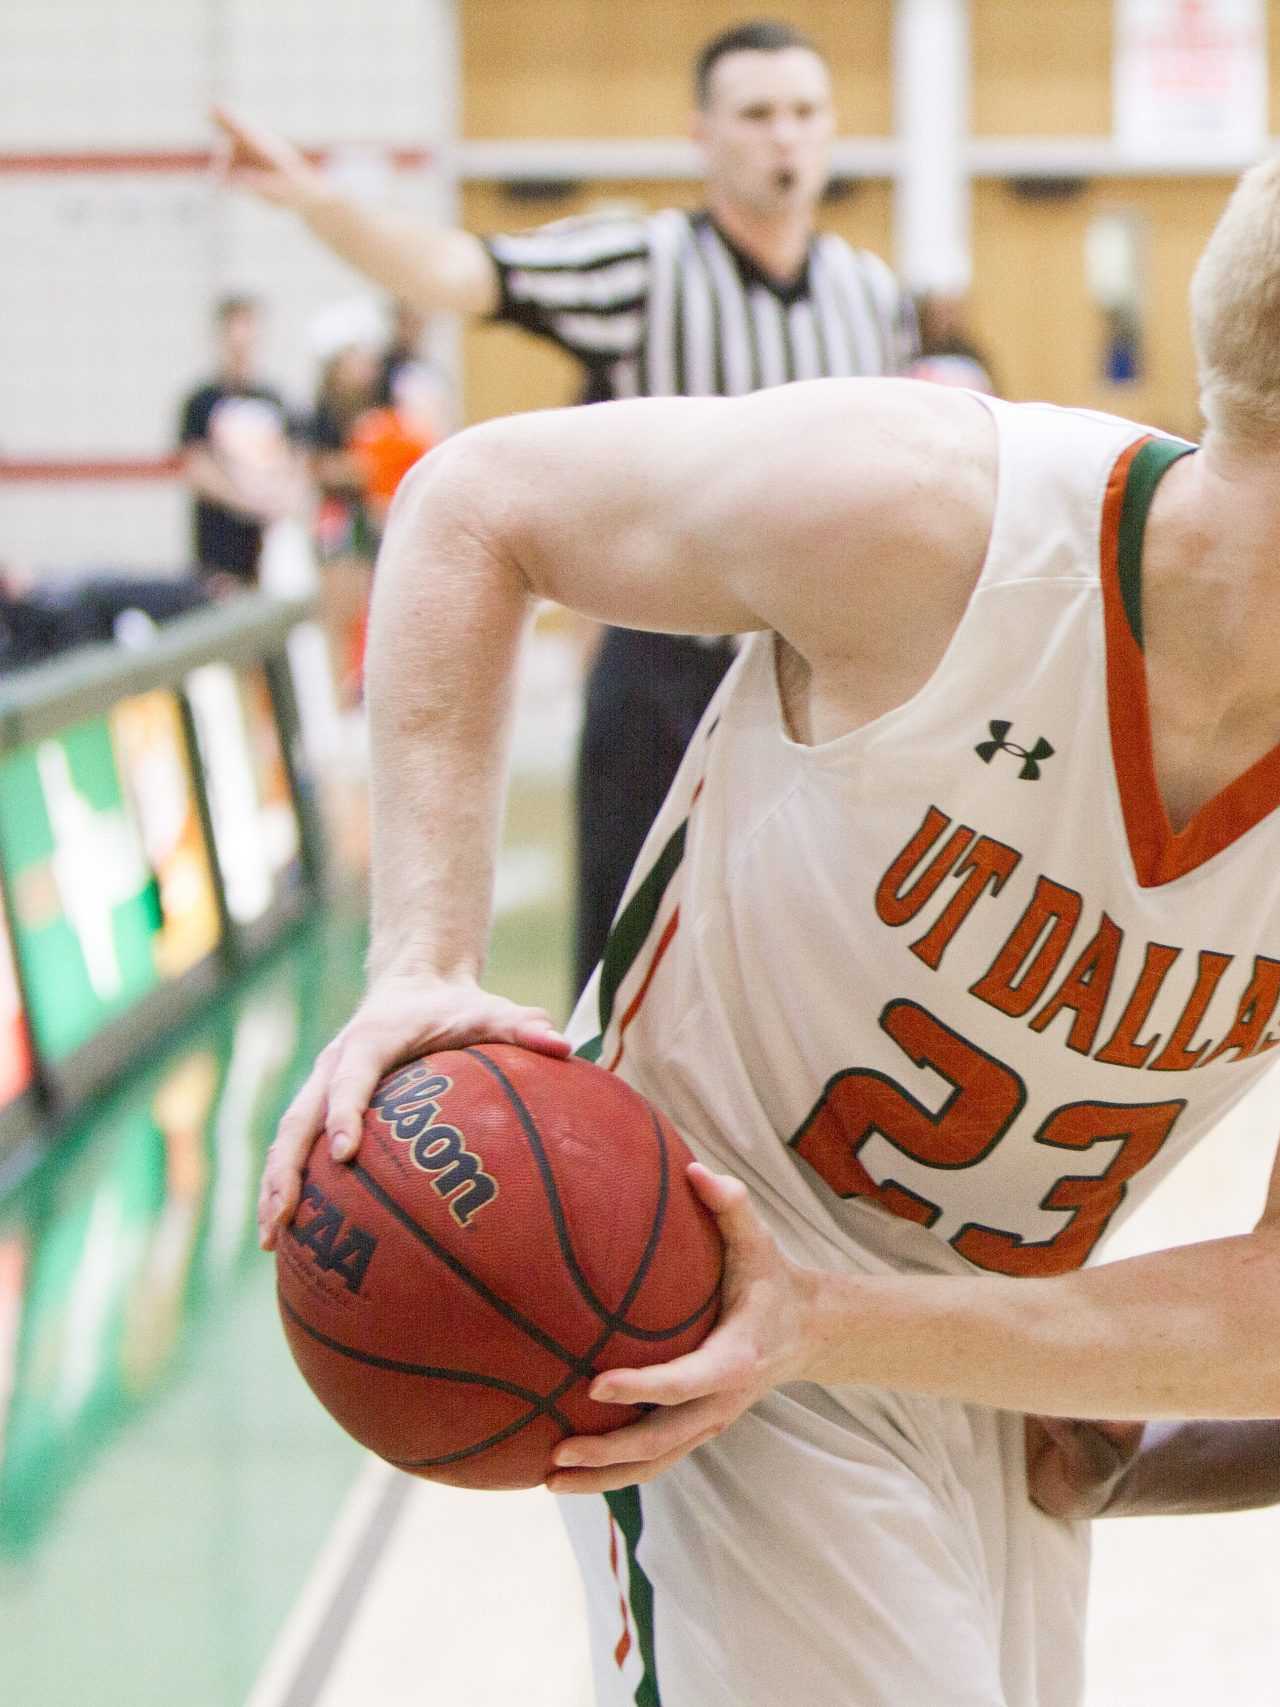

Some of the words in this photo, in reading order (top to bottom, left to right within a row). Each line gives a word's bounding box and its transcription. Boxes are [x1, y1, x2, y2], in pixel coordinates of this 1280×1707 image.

[875, 805, 1022, 971] UT
[370, 1060, 498, 1228] ilson
[788, 997, 1188, 1278] 23
